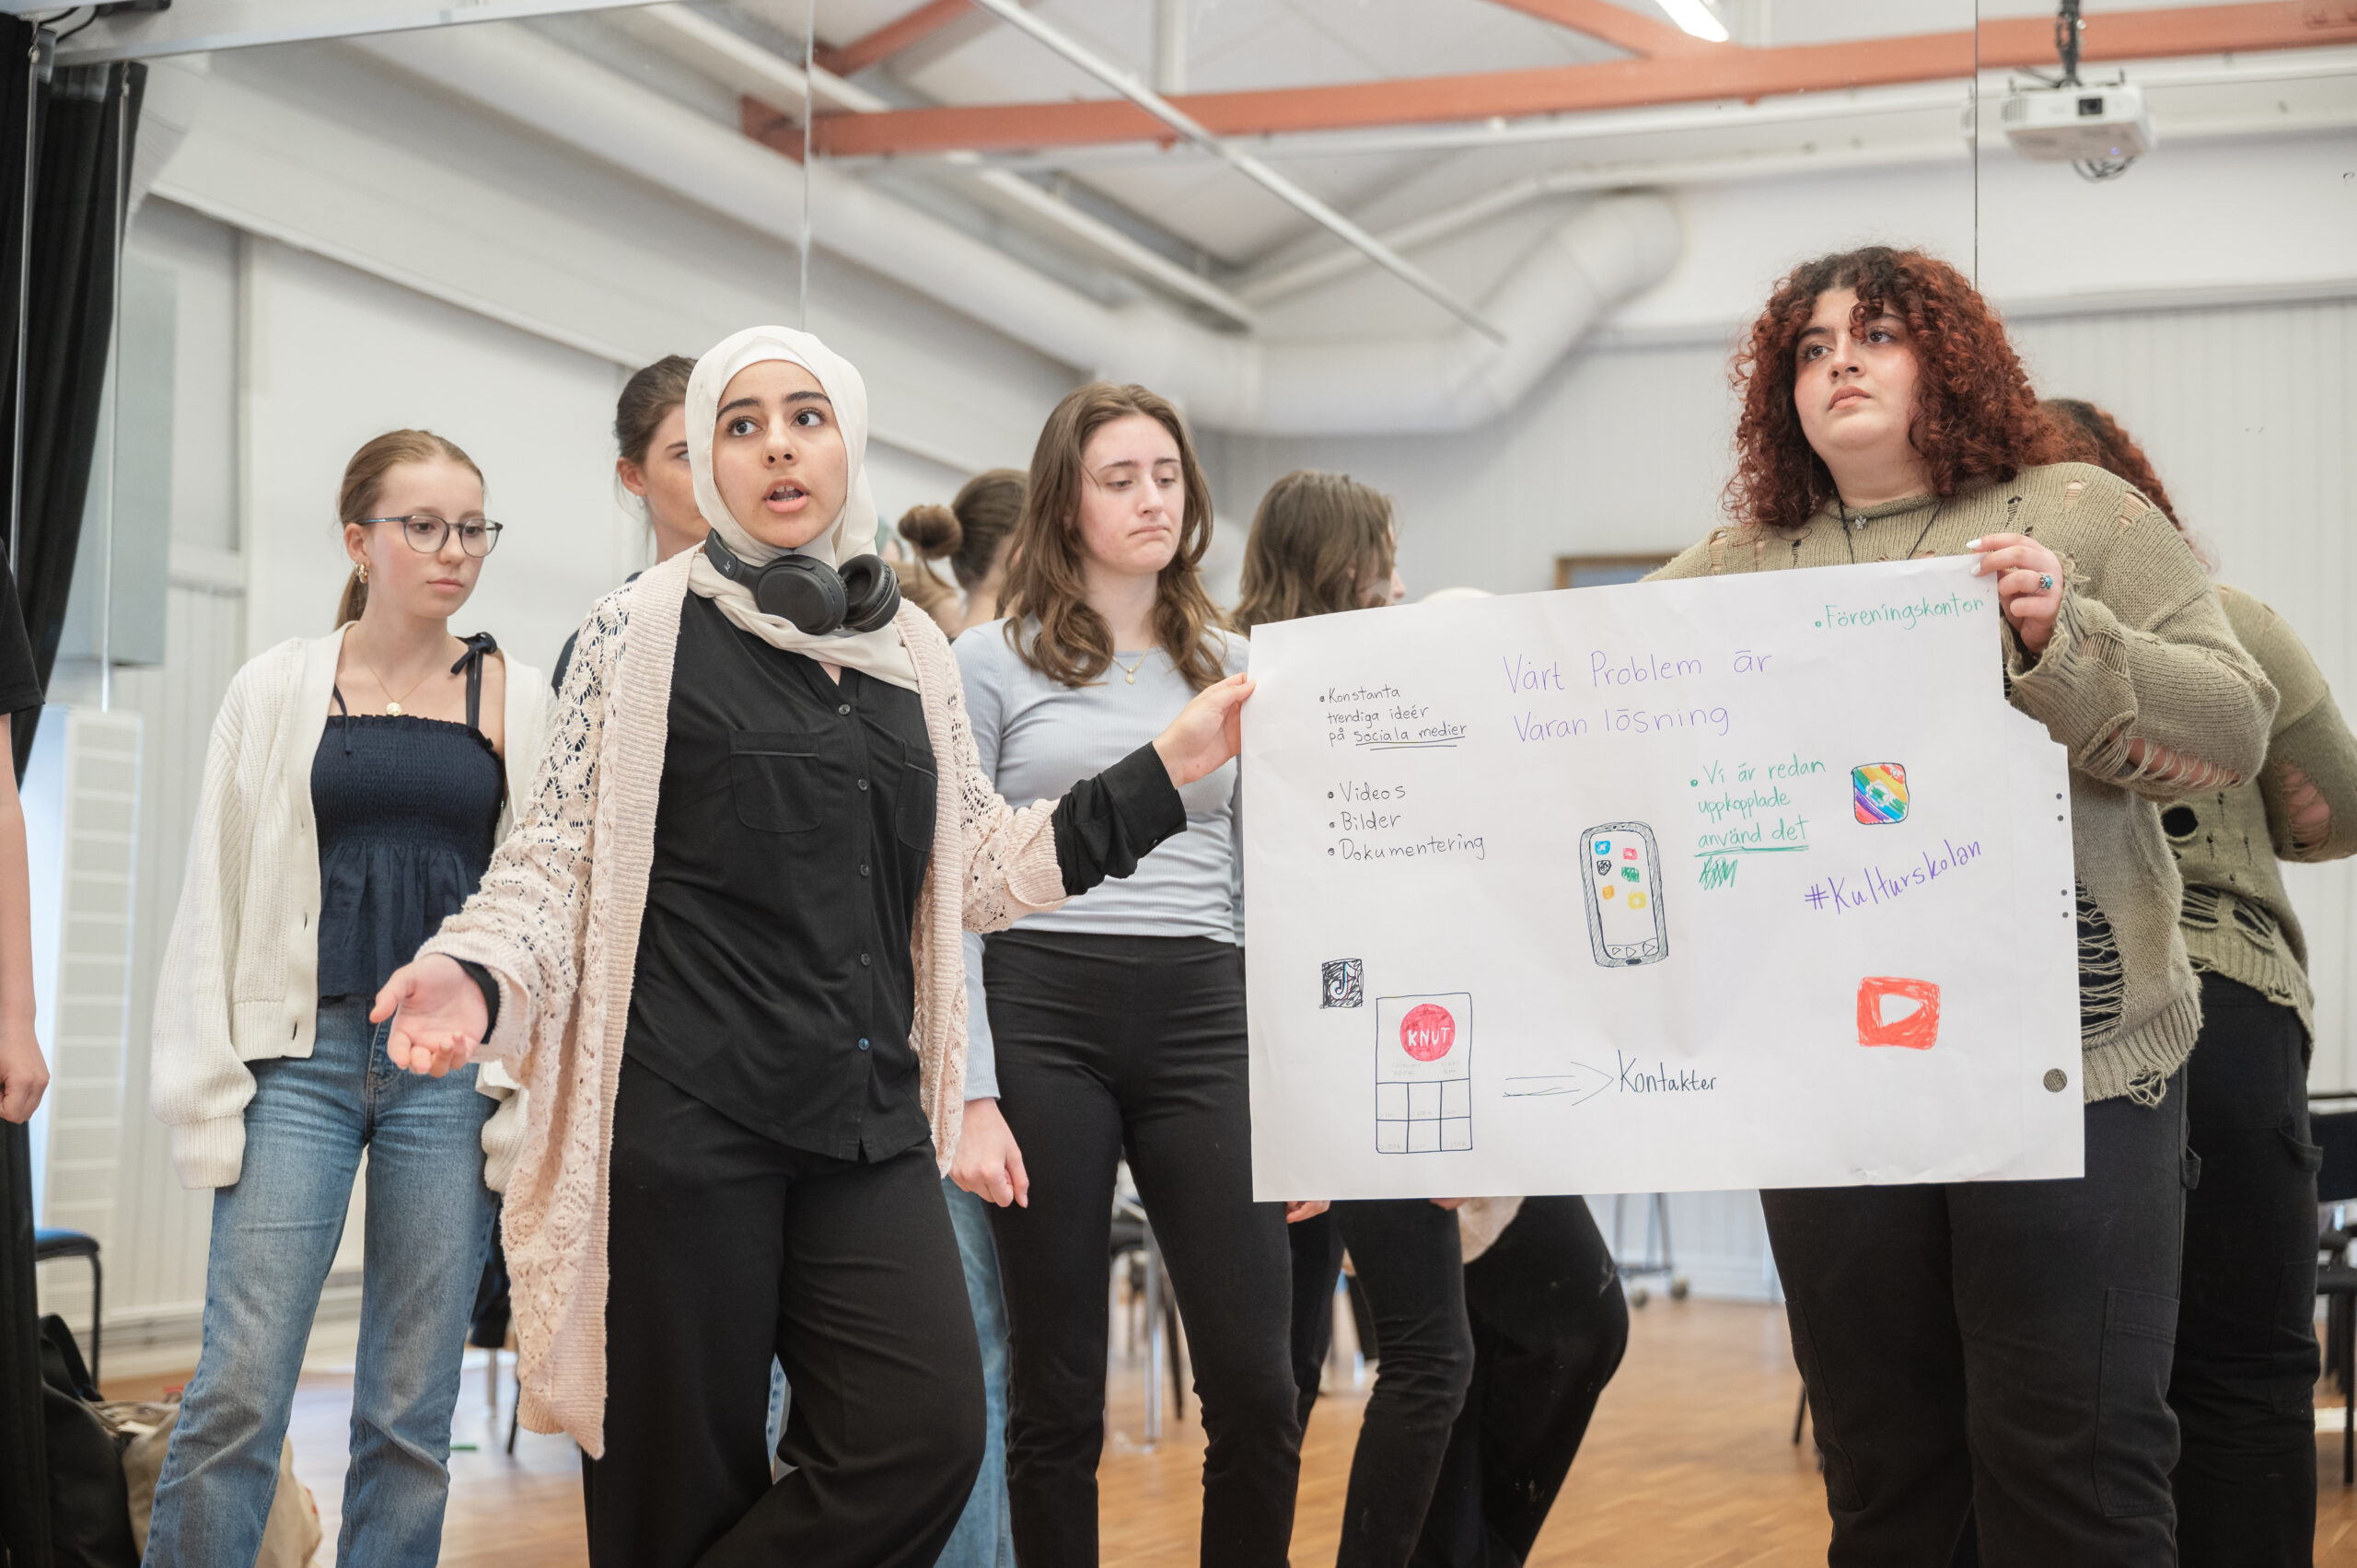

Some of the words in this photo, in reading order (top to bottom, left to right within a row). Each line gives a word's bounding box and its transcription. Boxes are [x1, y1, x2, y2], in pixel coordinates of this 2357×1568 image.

[1591, 650, 1701, 688] Problem
[1329, 684, 1399, 703] Konstanta
[1327, 709, 1379, 728] trendiga
[1329, 727, 1345, 748] på
[1354, 726, 1409, 742] sociala
[1418, 721, 1467, 738] medier
[1768, 753, 1826, 781] redan
[1339, 781, 1406, 802] Videos
[1341, 811, 1401, 830] Bilder
[1698, 818, 1761, 848] använd
[1771, 814, 1810, 842] det
[1339, 833, 1485, 860] Dokumentering
[1805, 839, 1981, 914] #Kulturskolan
[1408, 1028, 1450, 1047] KNUT
[1618, 1050, 1717, 1094] Kontakter
